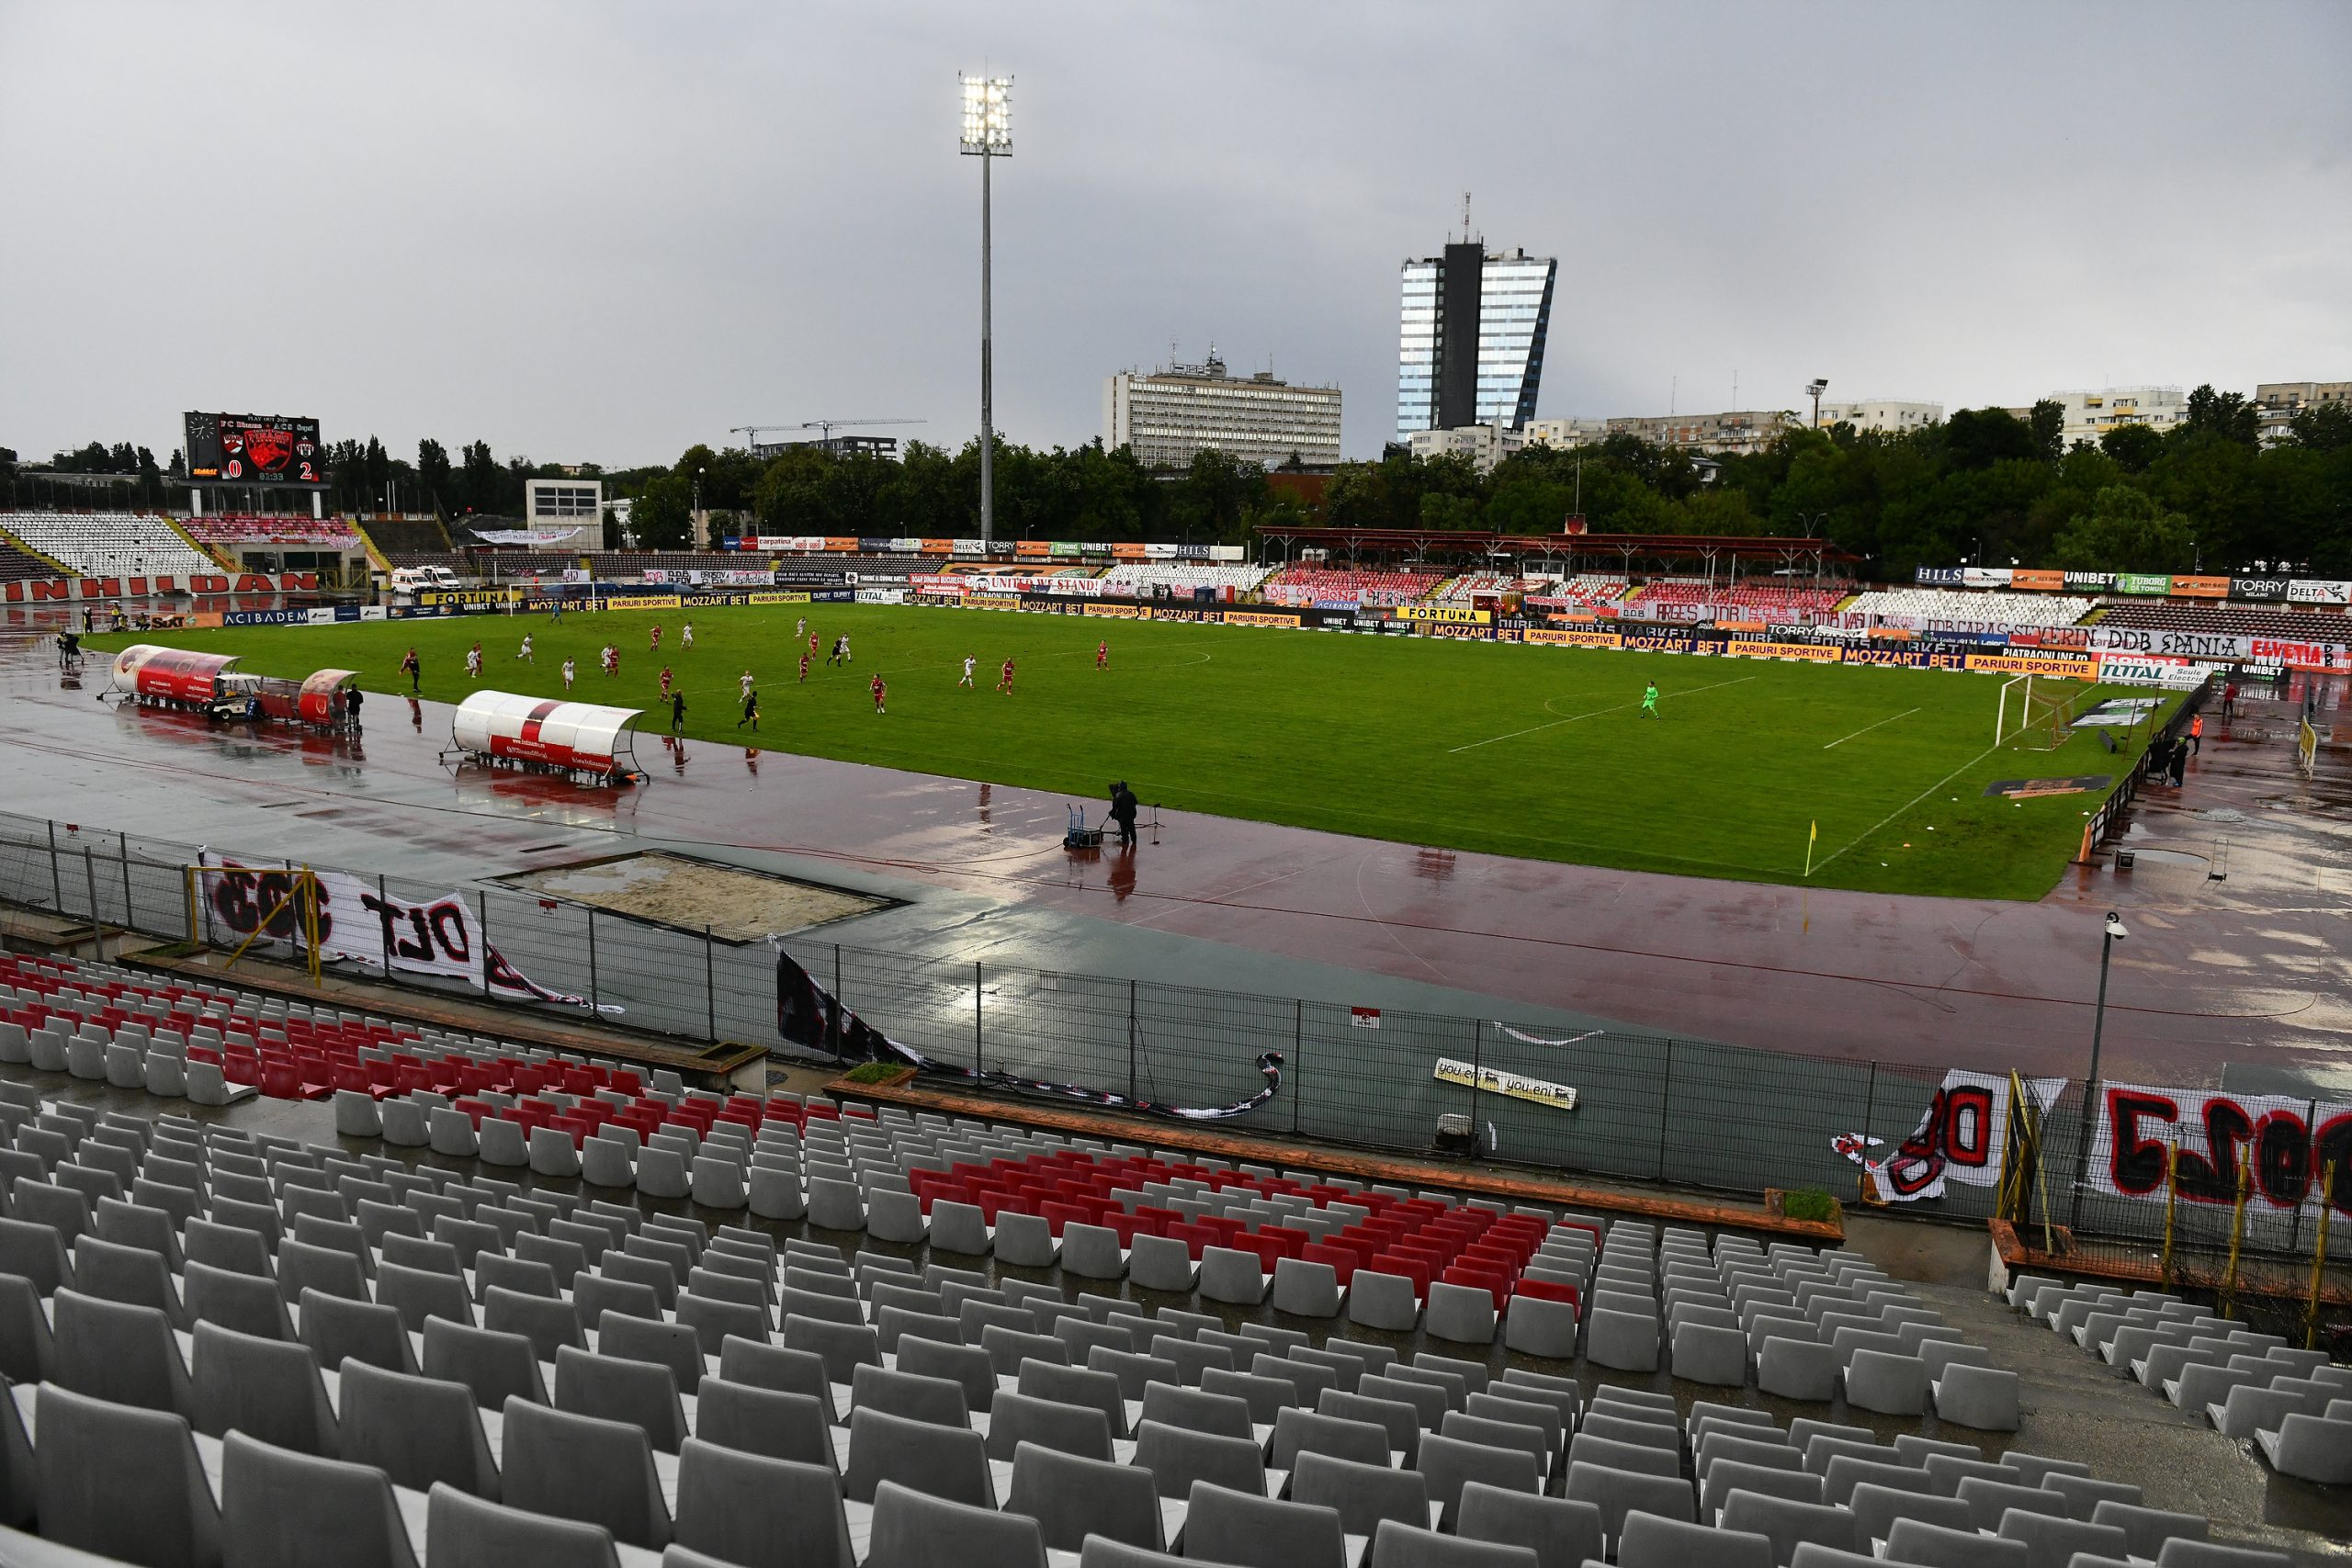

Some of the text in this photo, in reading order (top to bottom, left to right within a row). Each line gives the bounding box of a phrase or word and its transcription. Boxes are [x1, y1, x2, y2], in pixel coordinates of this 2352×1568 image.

[228, 459, 243, 479] 0
[300, 461, 313, 479] 2
[987, 541, 1015, 550] TORRY
[1080, 542, 1113, 551] UNIBET
[1179, 546, 1209, 556] HILS
[1918, 568, 1962, 581] HILS
[2064, 571, 2116, 584] UNIBET
[1057, 580, 1099, 592] STAND!
[2131, 576, 2166, 586] TUBORG
[2232, 580, 2288, 592] TORRY
[435, 592, 509, 604] FORTUNA
[2290, 587, 2325, 597] DELTA
[683, 595, 747, 607] MOZZART BET
[753, 593, 807, 604] PARIURI SPORTIVE
[904, 594, 959, 606] MOZZART BET
[988, 600, 1016, 608] SPORTIVE
[463, 603, 491, 611] UNIBET
[585, 600, 605, 611] BET
[1022, 602, 1081, 614] MOZZART BET
[1088, 605, 1114, 614] PARIURI
[224, 612, 309, 625] ACIBADEM
[1154, 608, 1222, 623] MOZZART BET
[1228, 614, 1295, 626] PARIURI SPORTIVE
[1408, 607, 1477, 622] FORTUNA
[1323, 616, 1348, 626] UNIBET
[1354, 619, 1380, 627] UNIBET
[1384, 621, 1411, 629] UNIBET
[1434, 625, 1521, 641] MOZZART BET
[1769, 625, 1815, 636] TORRY
[1531, 632, 1616, 645] PARIURI SPORTIVE
[2109, 629, 2152, 651] DDB
[1625, 637, 1724, 653] MOZZART BET
[1736, 644, 1834, 659] PARIURI SPORTIVE
[1844, 649, 1962, 668] MOZZART BET
[1974, 658, 2089, 674] PARIURI SPORTIVE
[2242, 664, 2284, 677] UNIBET
[2101, 665, 2165, 680] TOTAL
[2167, 673, 2206, 682] Electric
[1437, 1061, 1462, 1077] you
[1506, 1078, 1553, 1098] you eni
